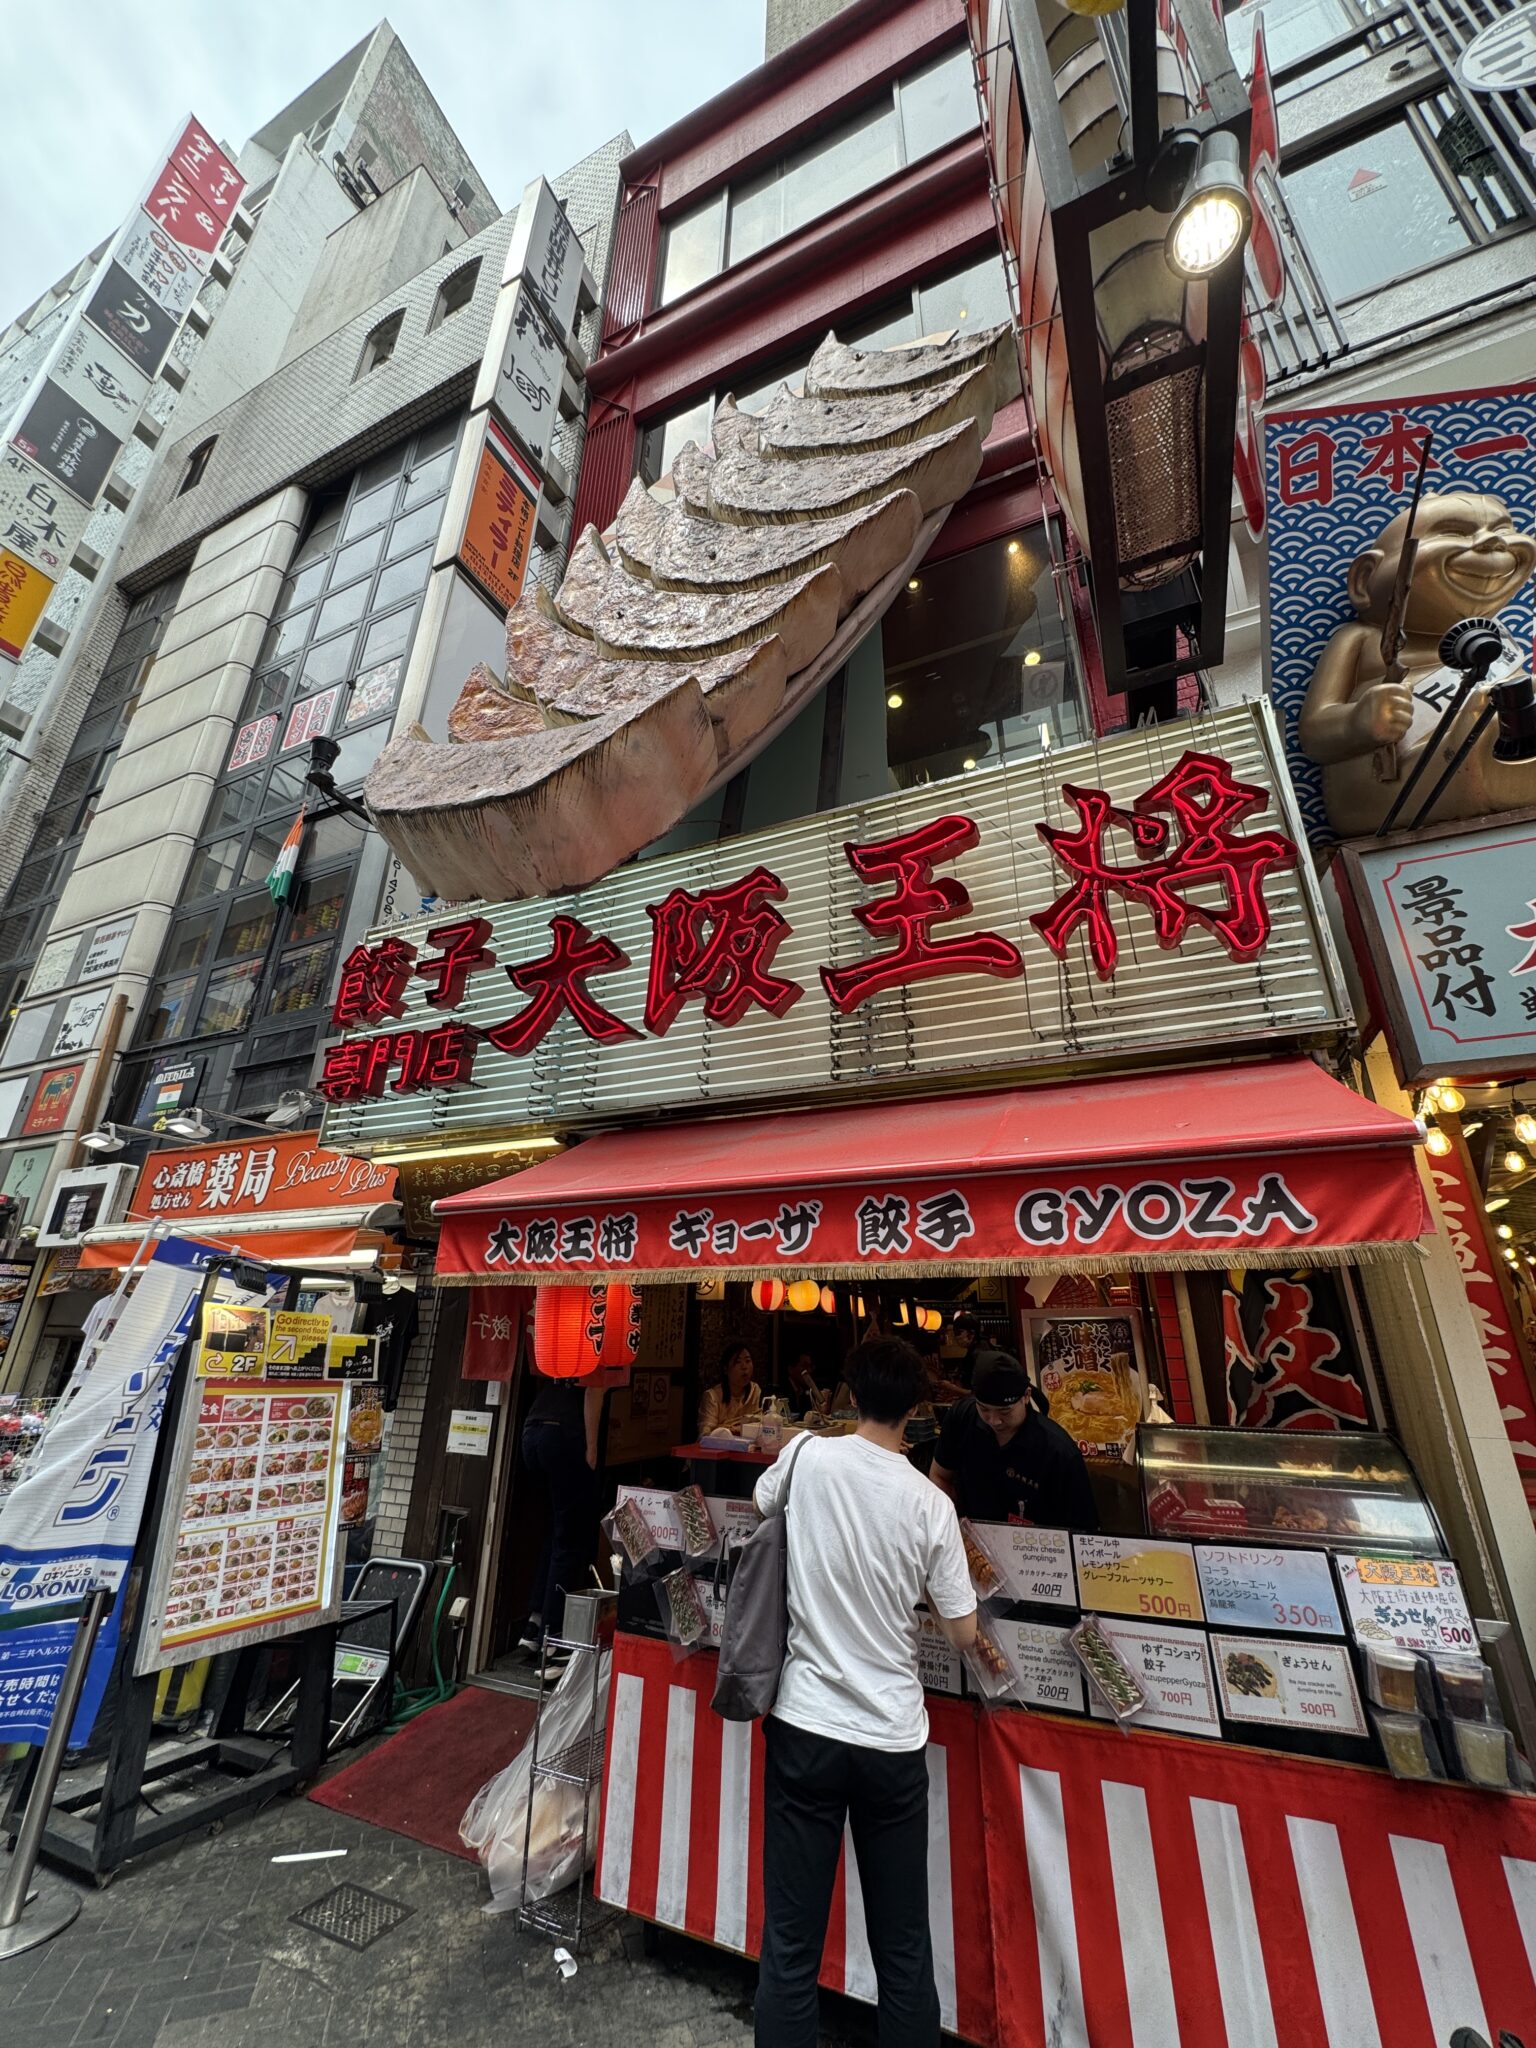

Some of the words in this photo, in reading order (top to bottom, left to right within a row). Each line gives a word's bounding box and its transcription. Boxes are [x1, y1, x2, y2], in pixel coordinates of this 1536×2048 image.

[16, 437, 34, 455] 5F
[6, 457, 32, 475] 4F
[1275, 413, 1530, 507] 日本一
[2, 482, 67, 559] 白木屋
[488, 472, 519, 571] ミティラー
[511, 496, 531, 570] 本格インド料理店
[506, 567, 520, 582] 2F
[485, 749, 1299, 1056] 大阪王将
[1401, 875, 1497, 1022] 景品付
[332, 917, 497, 1030] 餃子
[317, 1021, 482, 1103] 専門店
[32, 1116, 59, 1131] ミティラー
[197, 1147, 277, 1209] 薬局
[275, 1149, 351, 1192] Beauty
[340, 1161, 392, 1197] Plus
[149, 1189, 192, 1212] 処方せん
[484, 1211, 639, 1266] 大阪王将
[668, 1197, 824, 1260] ギョーザ
[855, 1187, 975, 1256] 餃子
[1014, 1172, 1319, 1247] GYOZA
[276, 1313, 292, 1325] Go
[292, 1316, 320, 1326] directly
[1058, 1323, 1075, 1373] ラーメン
[1071, 1322, 1099, 1372] 味噌
[231, 1355, 257, 1372] 2F
[651, 1525, 679, 1542] 800円
[1013, 1544, 1039, 1553] crunchy
[1040, 1545, 1065, 1554] cheese
[1079, 1537, 1121, 1548] 生ビール中
[1022, 1553, 1057, 1564] dumplings
[1080, 1549, 1121, 1560] ハイボール
[1203, 1550, 1286, 1567] ソフトドリンク
[1082, 1559, 1130, 1571] レモンサワー
[1203, 1565, 1230, 1576] コーラ
[1363, 1562, 1434, 1583] 大阪王将
[1018, 1569, 1069, 1580] カリカリチーズ餃子
[1082, 1571, 1174, 1587] グレープフルーツサワー
[1031, 1582, 1062, 1597] 400円
[1205, 1577, 1277, 1591] ジンジャーエール
[1207, 1588, 1281, 1602] オレンジジュース
[1138, 1593, 1193, 1618] 500円
[1209, 1598, 1237, 1610] 烏龍茶
[1272, 1602, 1334, 1629] 350円
[1374, 1605, 1438, 1628] ぎょうせん
[1440, 1625, 1472, 1644] 500
[1017, 1643, 1044, 1654] Ketchup
[1141, 1643, 1201, 1662] ゆずコショウ
[1018, 1653, 1042, 1663] cheese
[1042, 1656, 1077, 1668] dumplings
[1143, 1657, 1167, 1673] 餃子
[1281, 1655, 1333, 1673] ぎょうせん
[923, 1672, 949, 1689] 800円
[1037, 1684, 1069, 1701] 500円
[1160, 1690, 1193, 1706] 700円
[1299, 1702, 1338, 1719] 500円
